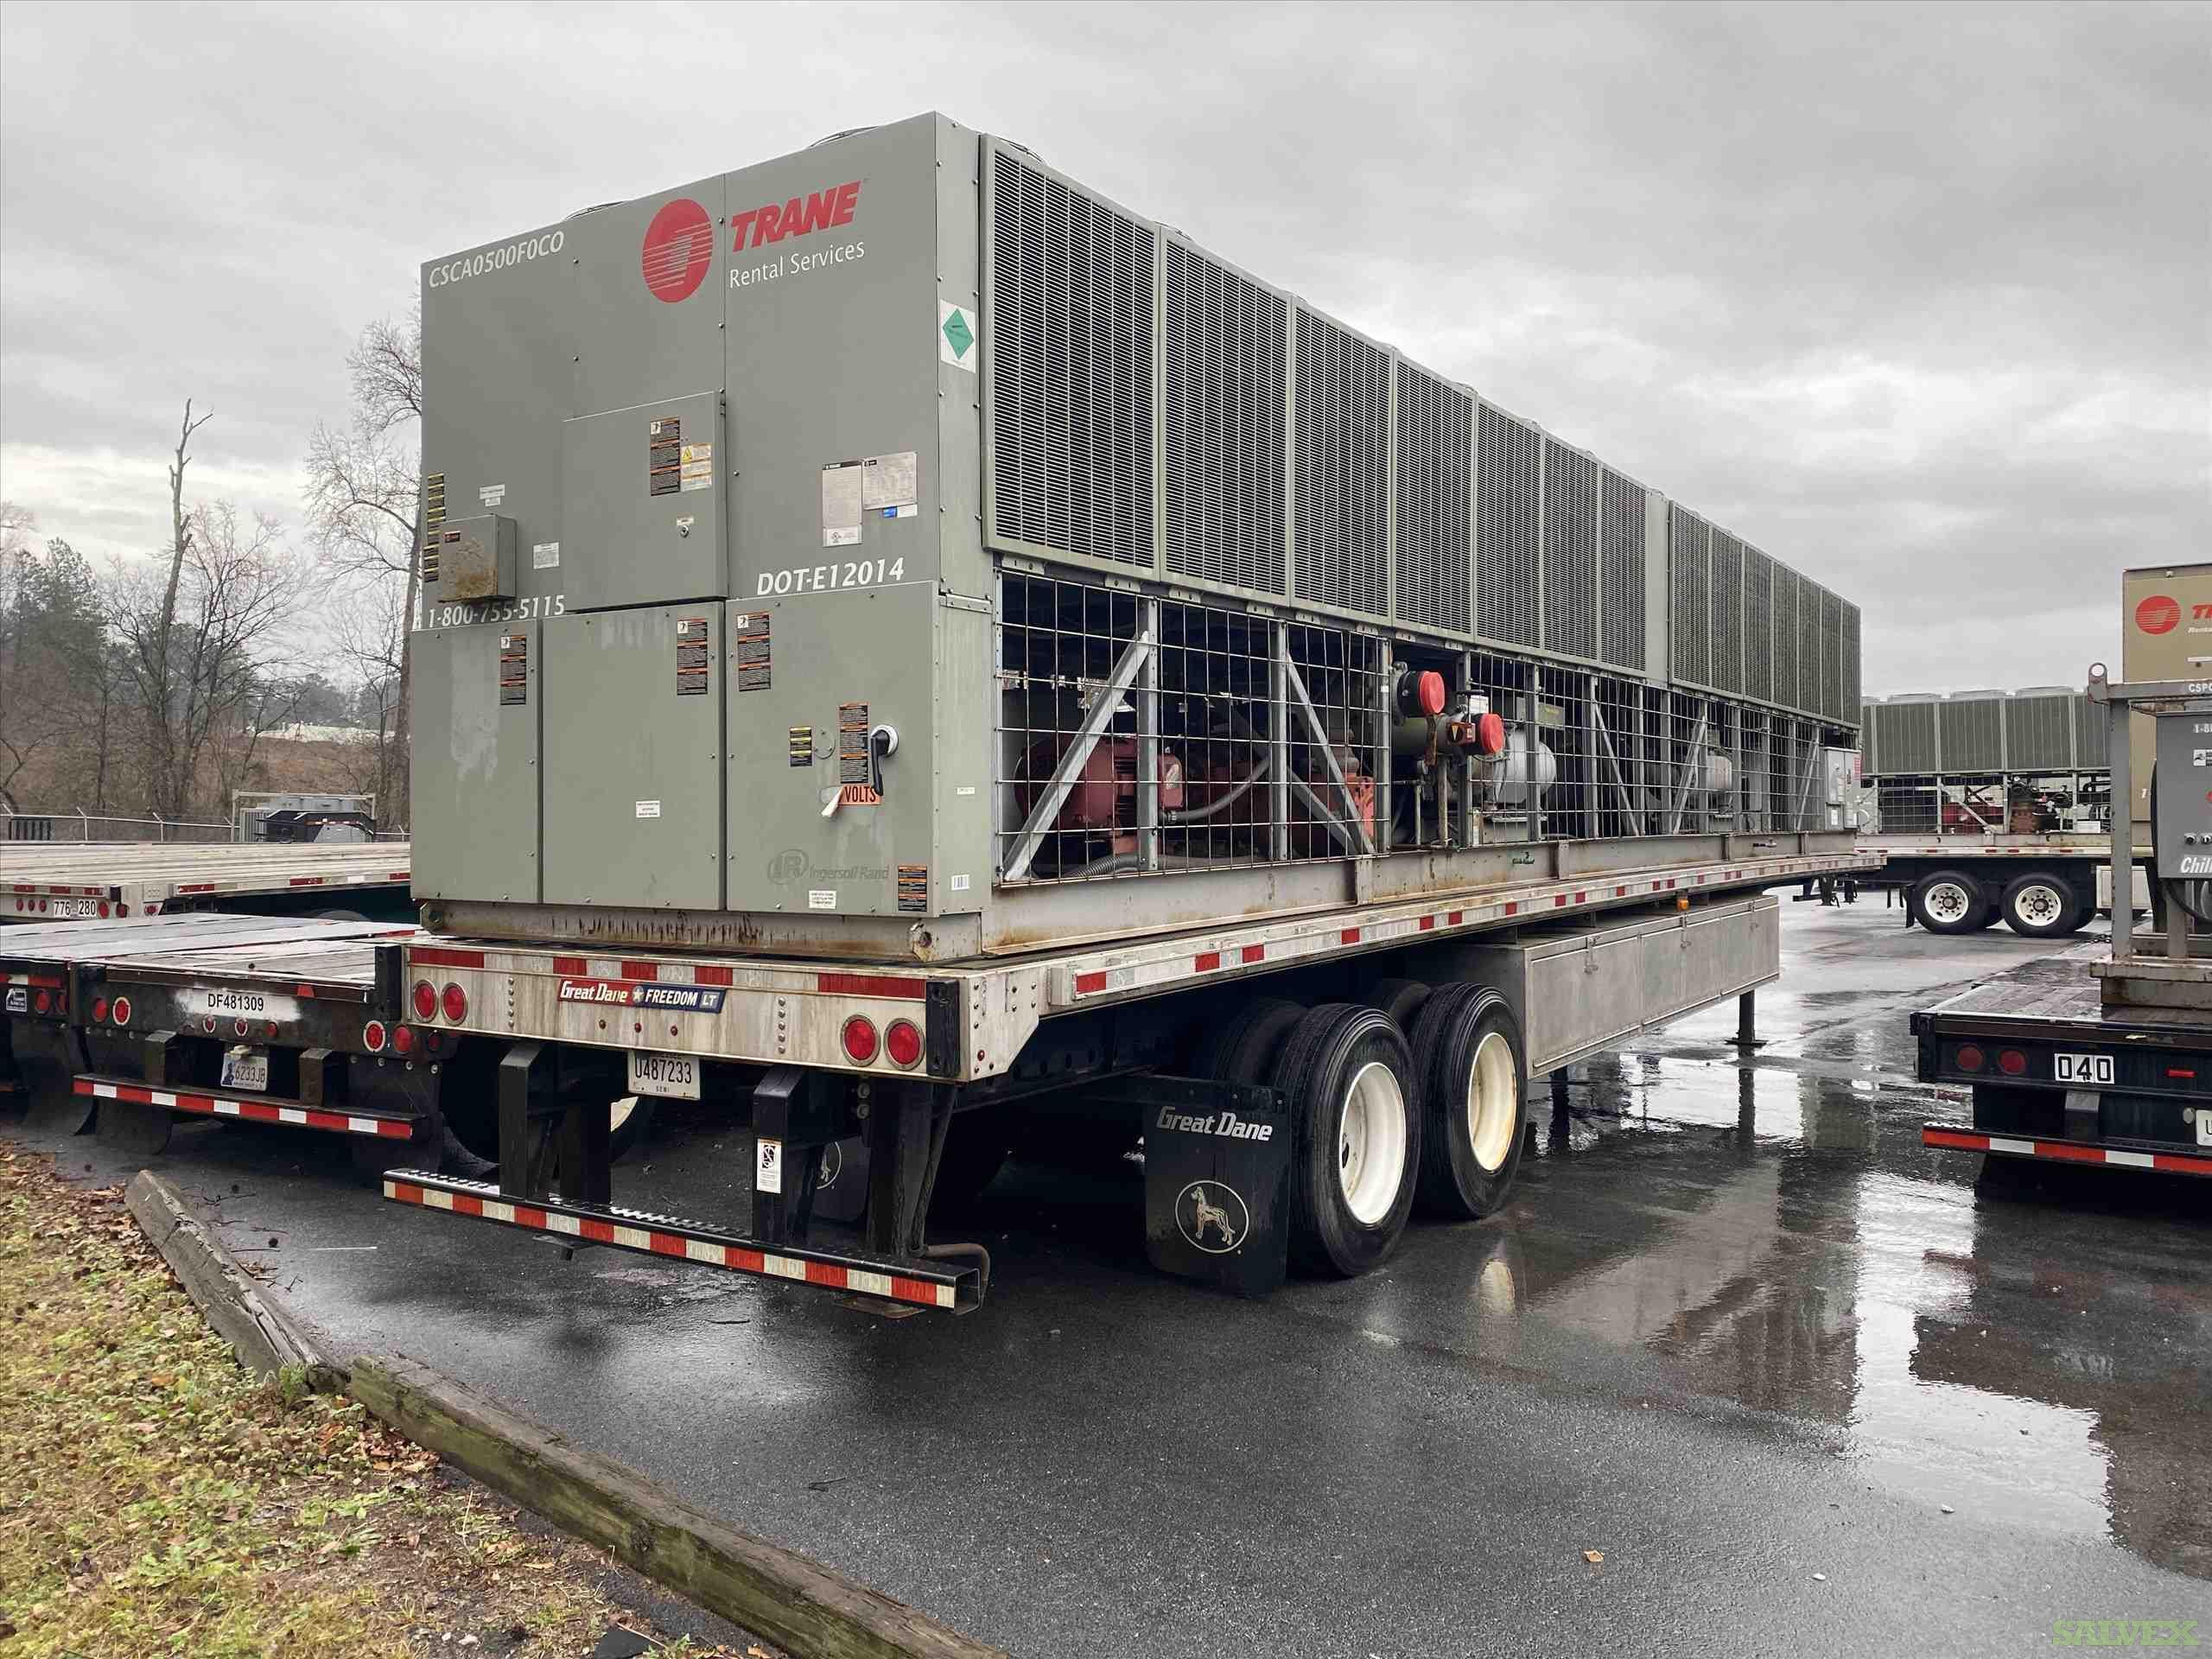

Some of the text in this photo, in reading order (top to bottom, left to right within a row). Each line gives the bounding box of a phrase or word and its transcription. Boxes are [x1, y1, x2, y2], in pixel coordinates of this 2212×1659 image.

[732, 180, 861, 252] TRANE
[729, 241, 865, 289] Rental Services
[757, 556, 905, 595] DOT-E12014
[429, 594, 566, 628] 1-800-755-5115
[844, 785, 876, 803] VOLTS
[54, 900, 96, 915] 776 280
[207, 994, 264, 1011] DF481309
[560, 980, 717, 1007] Great Dane FREEDOM LT
[2058, 1056, 2111, 1081] 040
[1156, 1106, 1273, 1141] Great Dane
